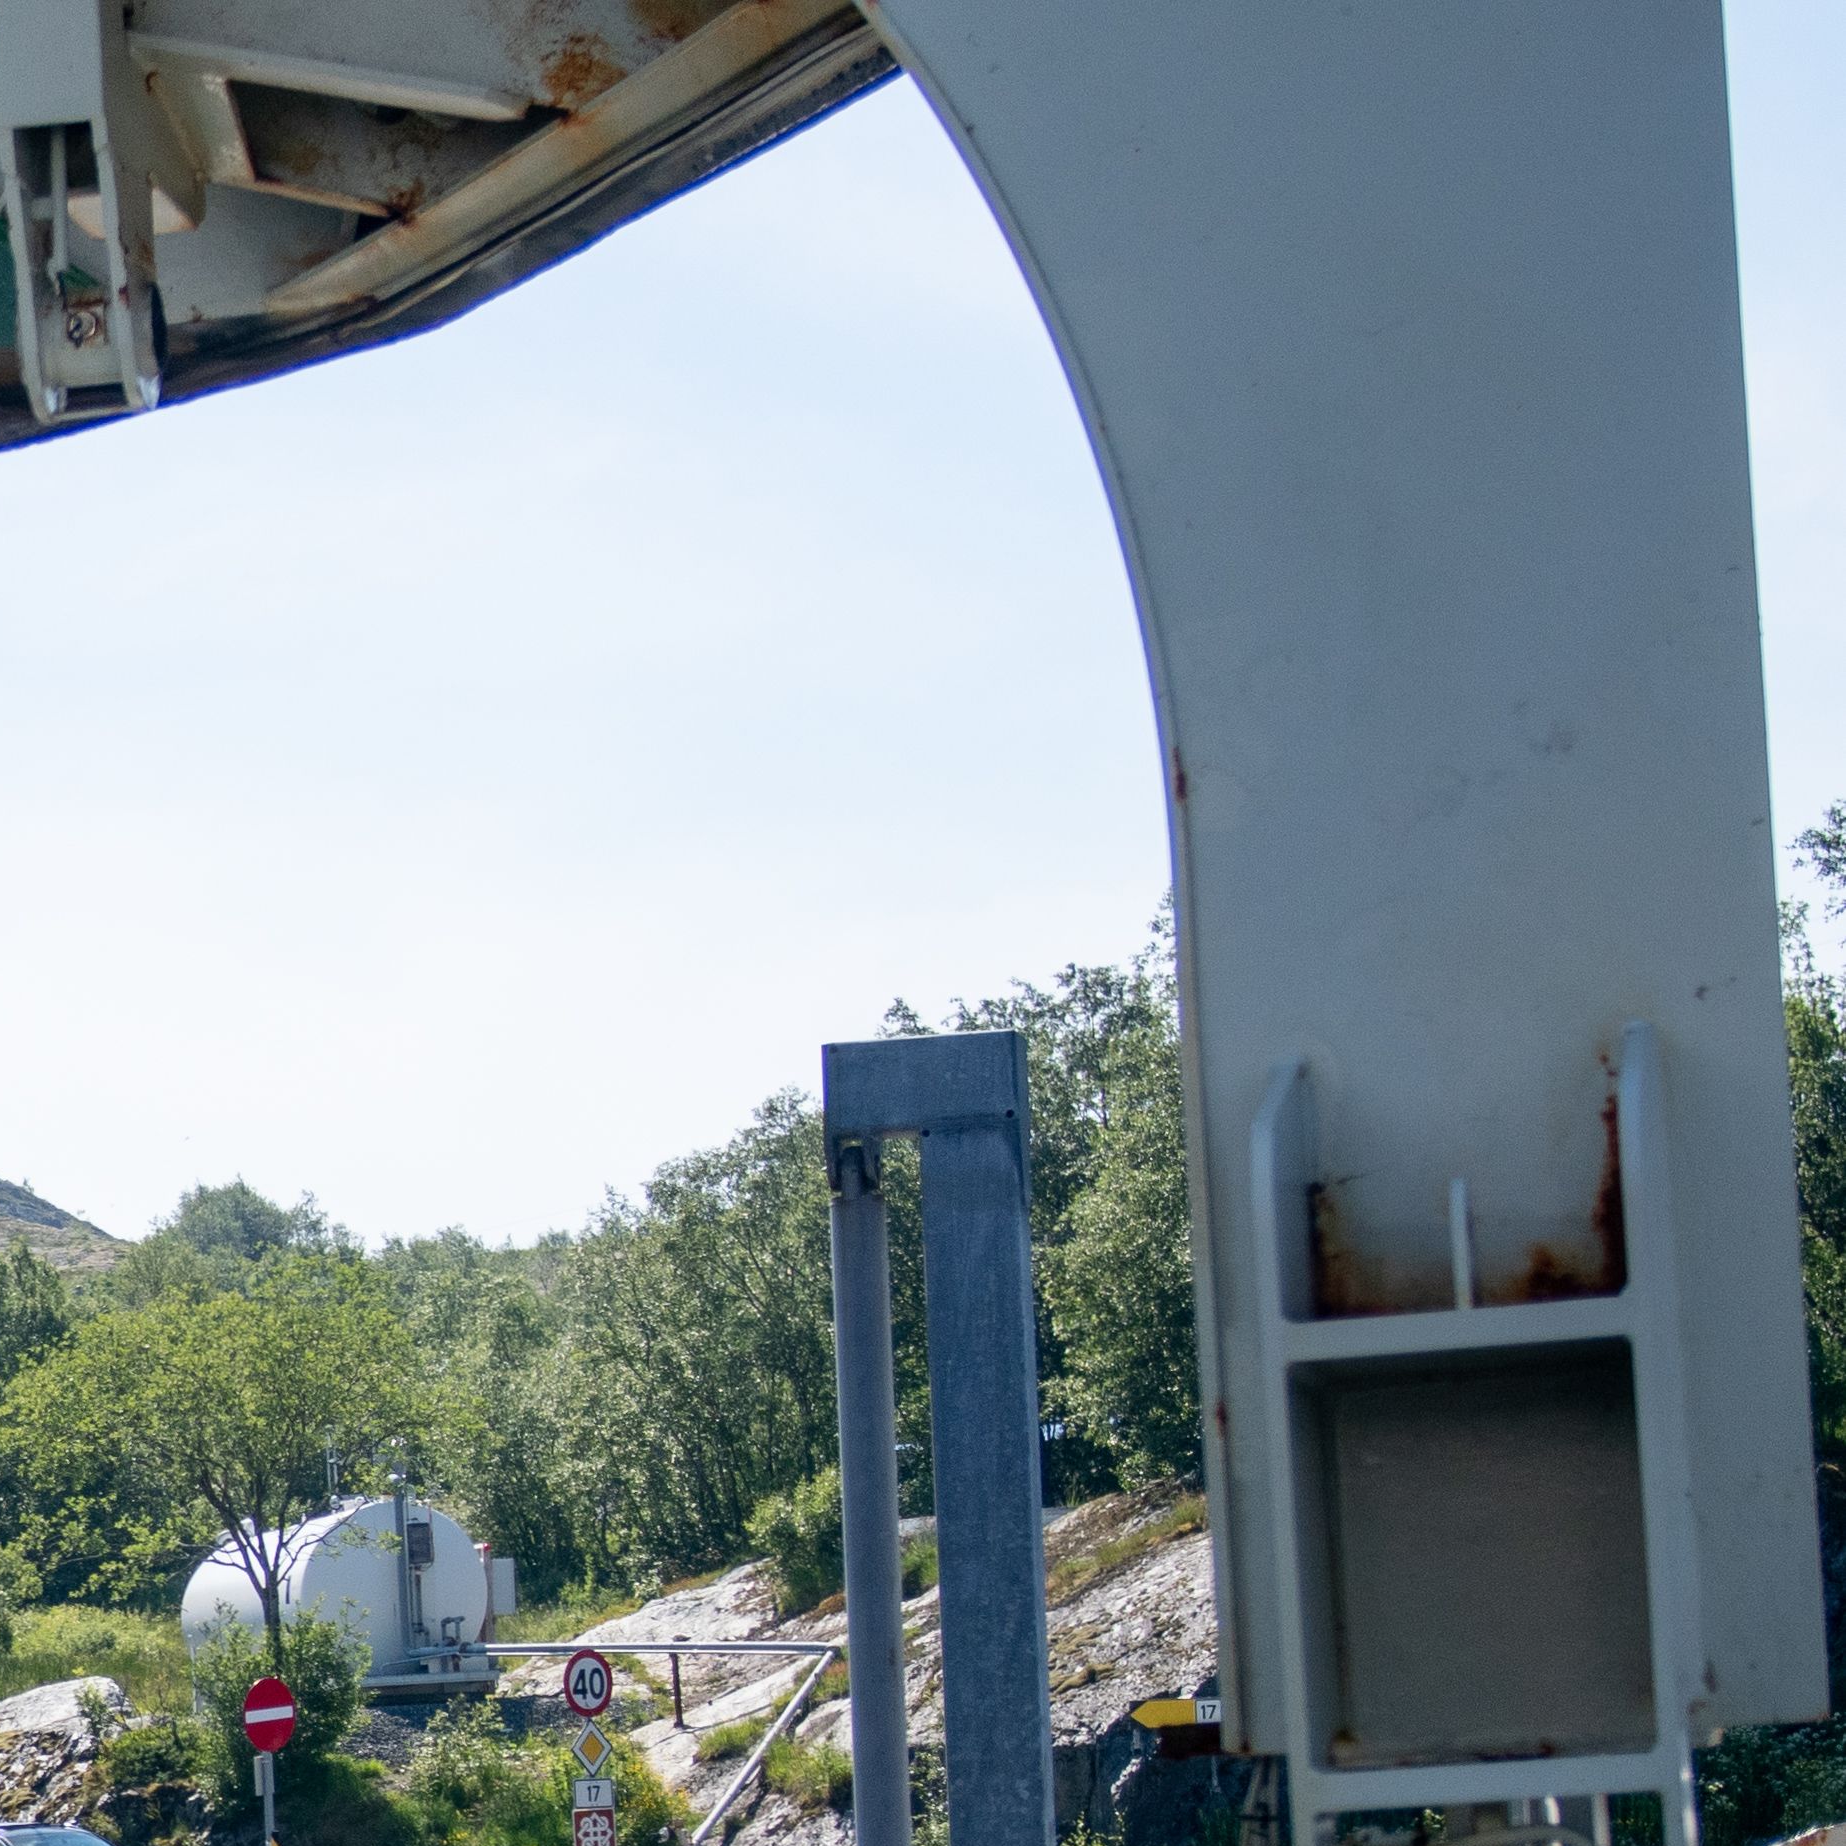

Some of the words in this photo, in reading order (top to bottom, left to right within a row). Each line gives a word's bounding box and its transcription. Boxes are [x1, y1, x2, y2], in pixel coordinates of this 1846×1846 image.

[573, 1668, 605, 1700] 40
[1200, 1704, 1217, 1720] 17
[587, 1785, 600, 1802] 17
